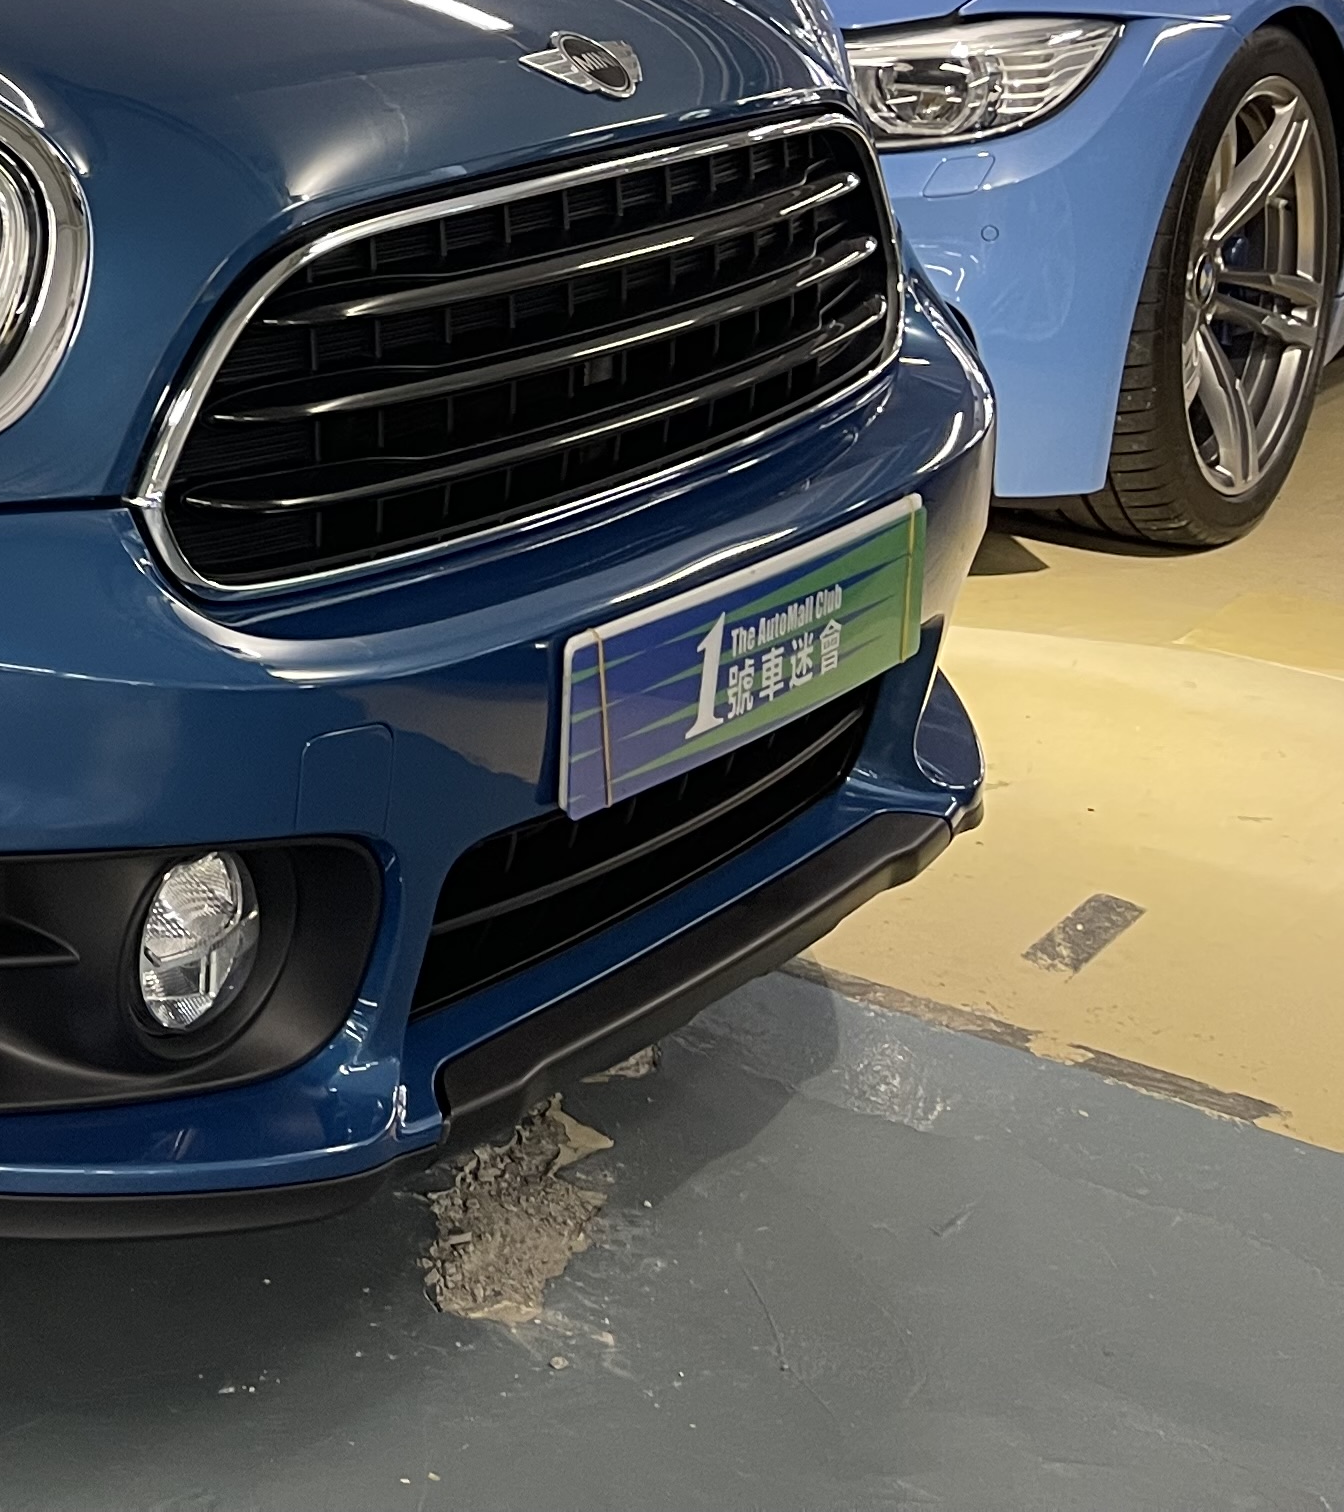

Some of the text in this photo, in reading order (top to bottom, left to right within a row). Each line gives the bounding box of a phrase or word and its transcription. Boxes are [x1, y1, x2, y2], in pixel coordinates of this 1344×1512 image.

[727, 618, 843, 719] 號車迷會
[731, 583, 843, 658] The AutoMall Club
[685, 611, 725, 739] 1
